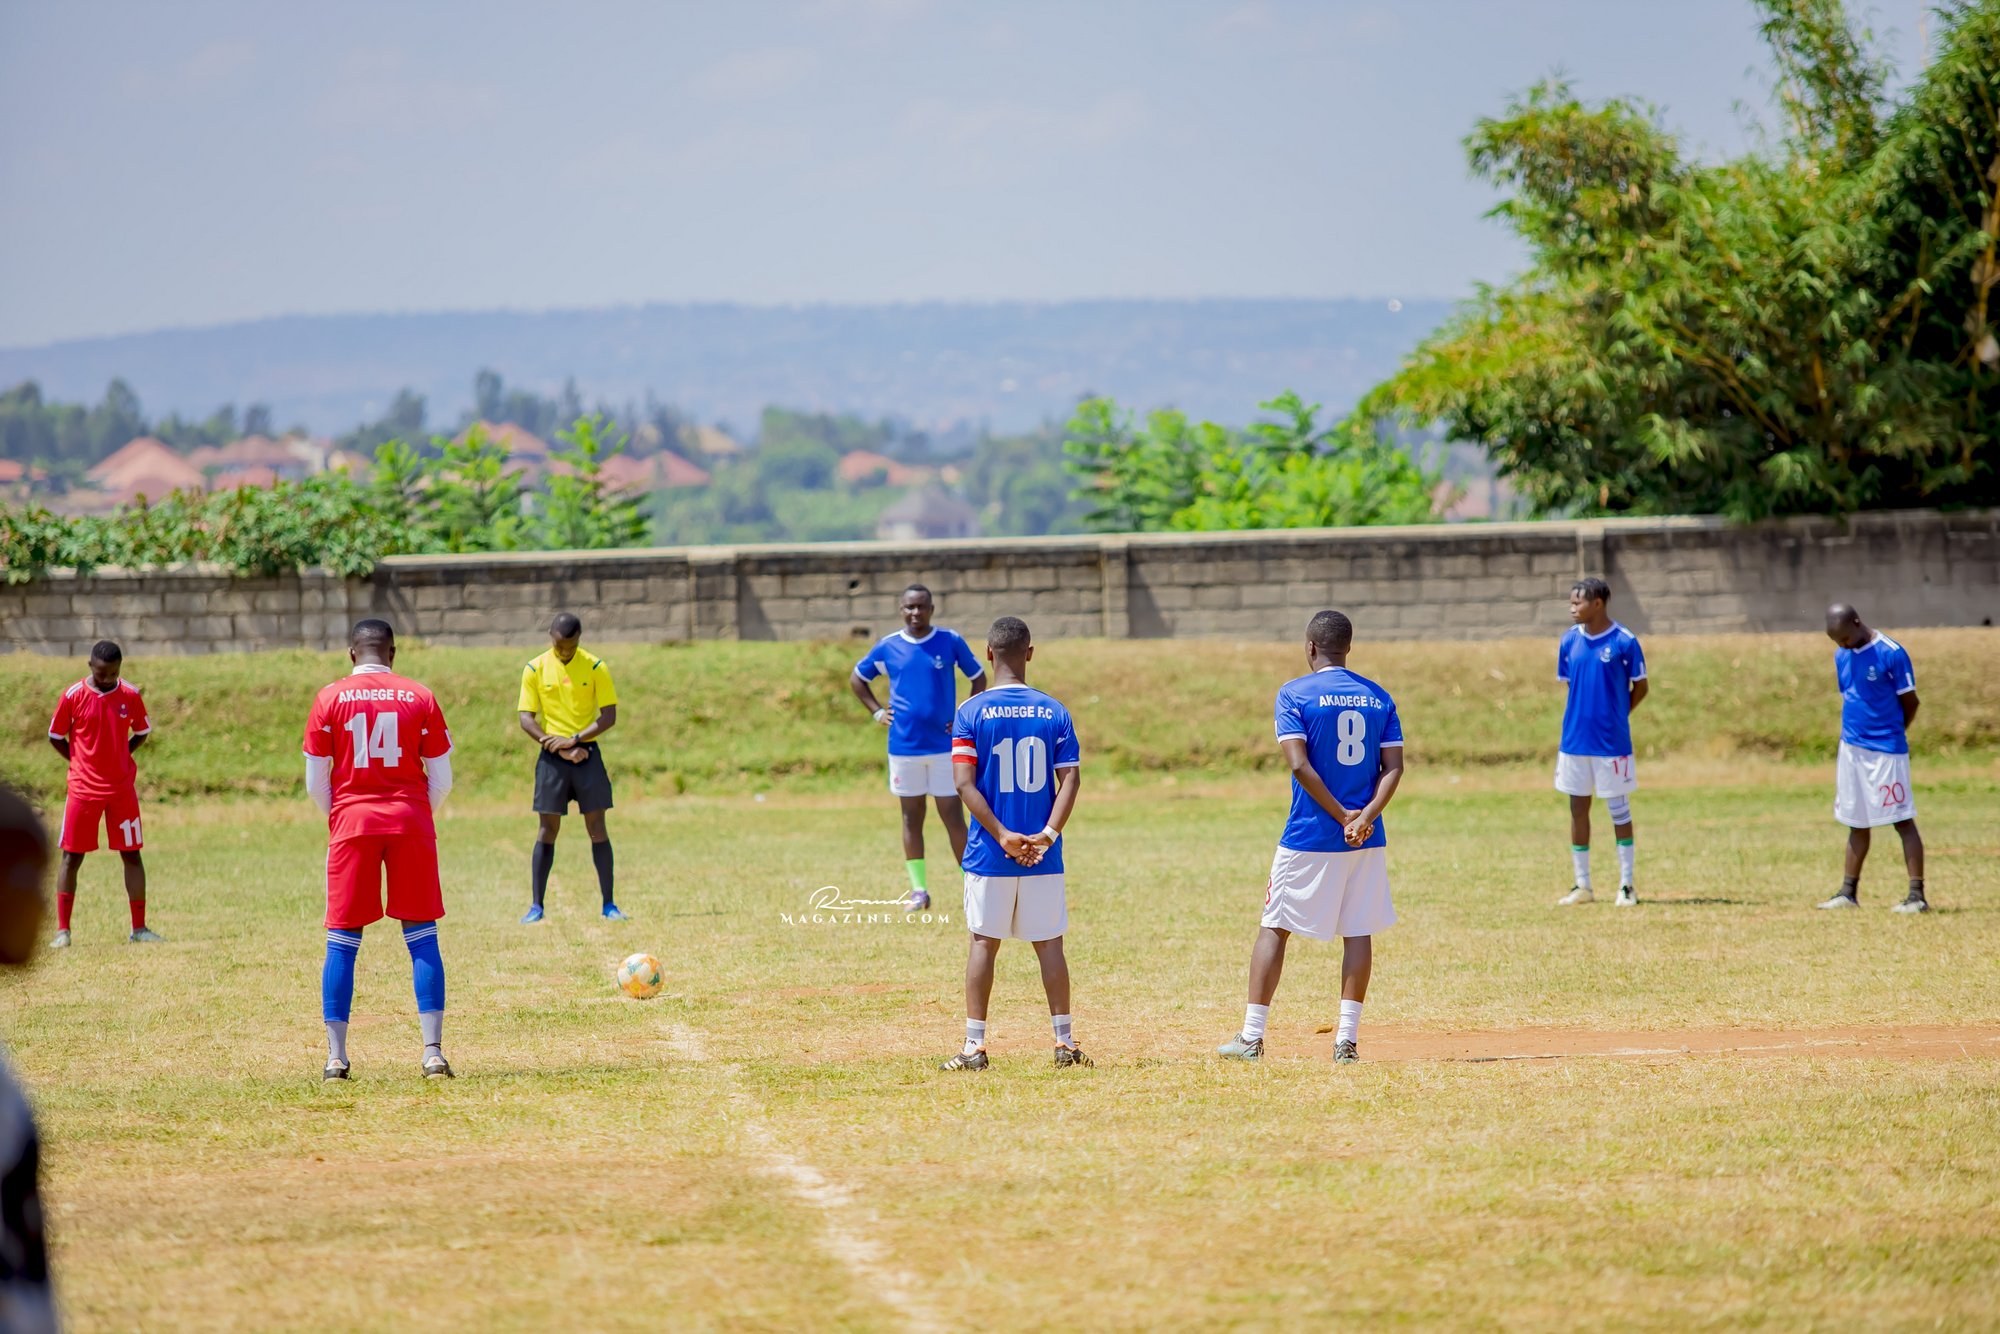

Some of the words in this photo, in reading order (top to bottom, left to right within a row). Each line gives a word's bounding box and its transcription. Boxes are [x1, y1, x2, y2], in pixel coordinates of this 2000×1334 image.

[339, 688, 394, 703] AKADEGE
[397, 689, 414, 702] F.C
[1320, 695, 1368, 707] AKADEGE
[1370, 696, 1382, 709] F.C
[982, 706, 1034, 720] AKADEGE
[1037, 706, 1053, 720] F.C
[344, 712, 402, 768] 14
[1337, 710, 1366, 766] 8
[992, 736, 1046, 793] 10
[1612, 755, 1629, 777] 17
[1879, 782, 1905, 807] 20
[119, 816, 143, 847] 11
